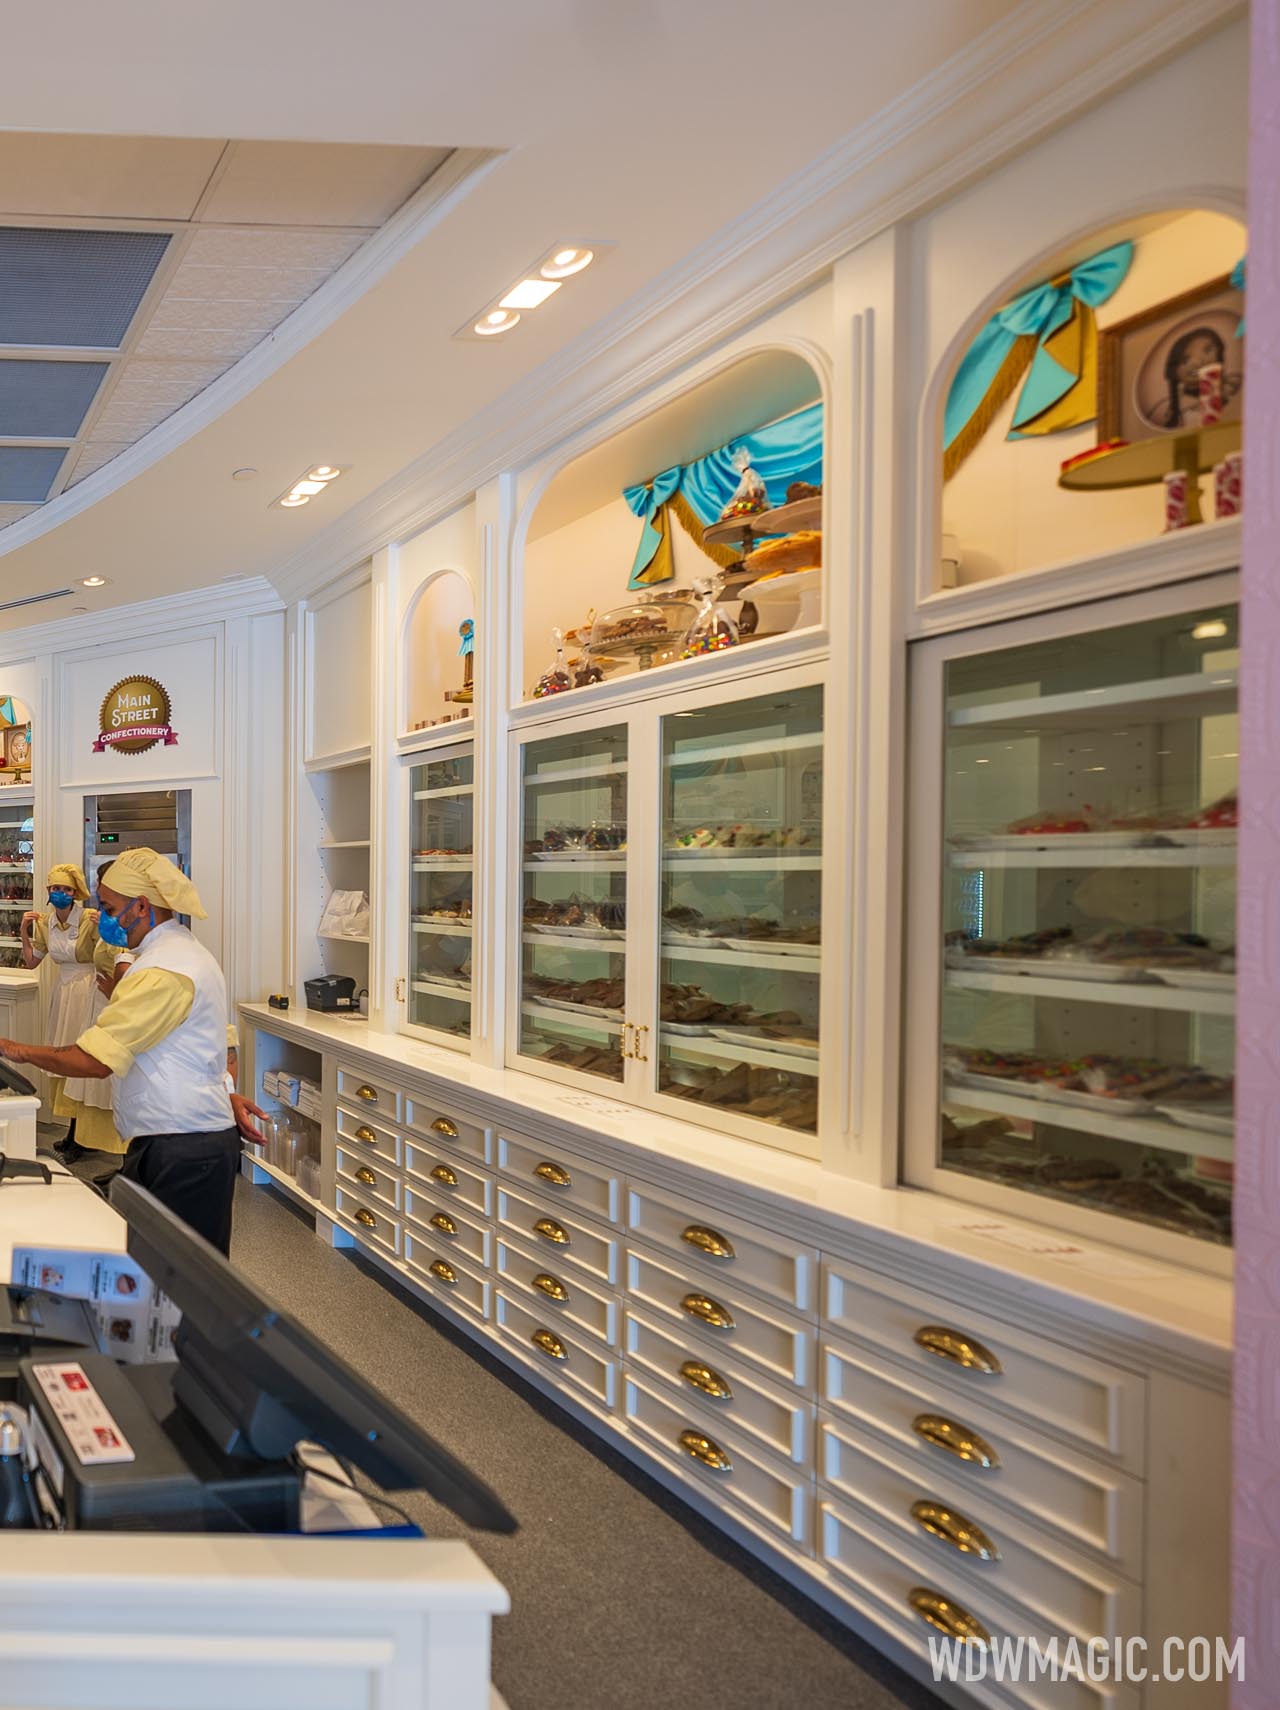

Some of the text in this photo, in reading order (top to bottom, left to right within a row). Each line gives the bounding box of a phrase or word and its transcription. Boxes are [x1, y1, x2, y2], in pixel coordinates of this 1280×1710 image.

[117, 693, 151, 708] MAIN
[111, 708, 159, 727] STREET
[100, 727, 169, 742] CONFECTIONERY
